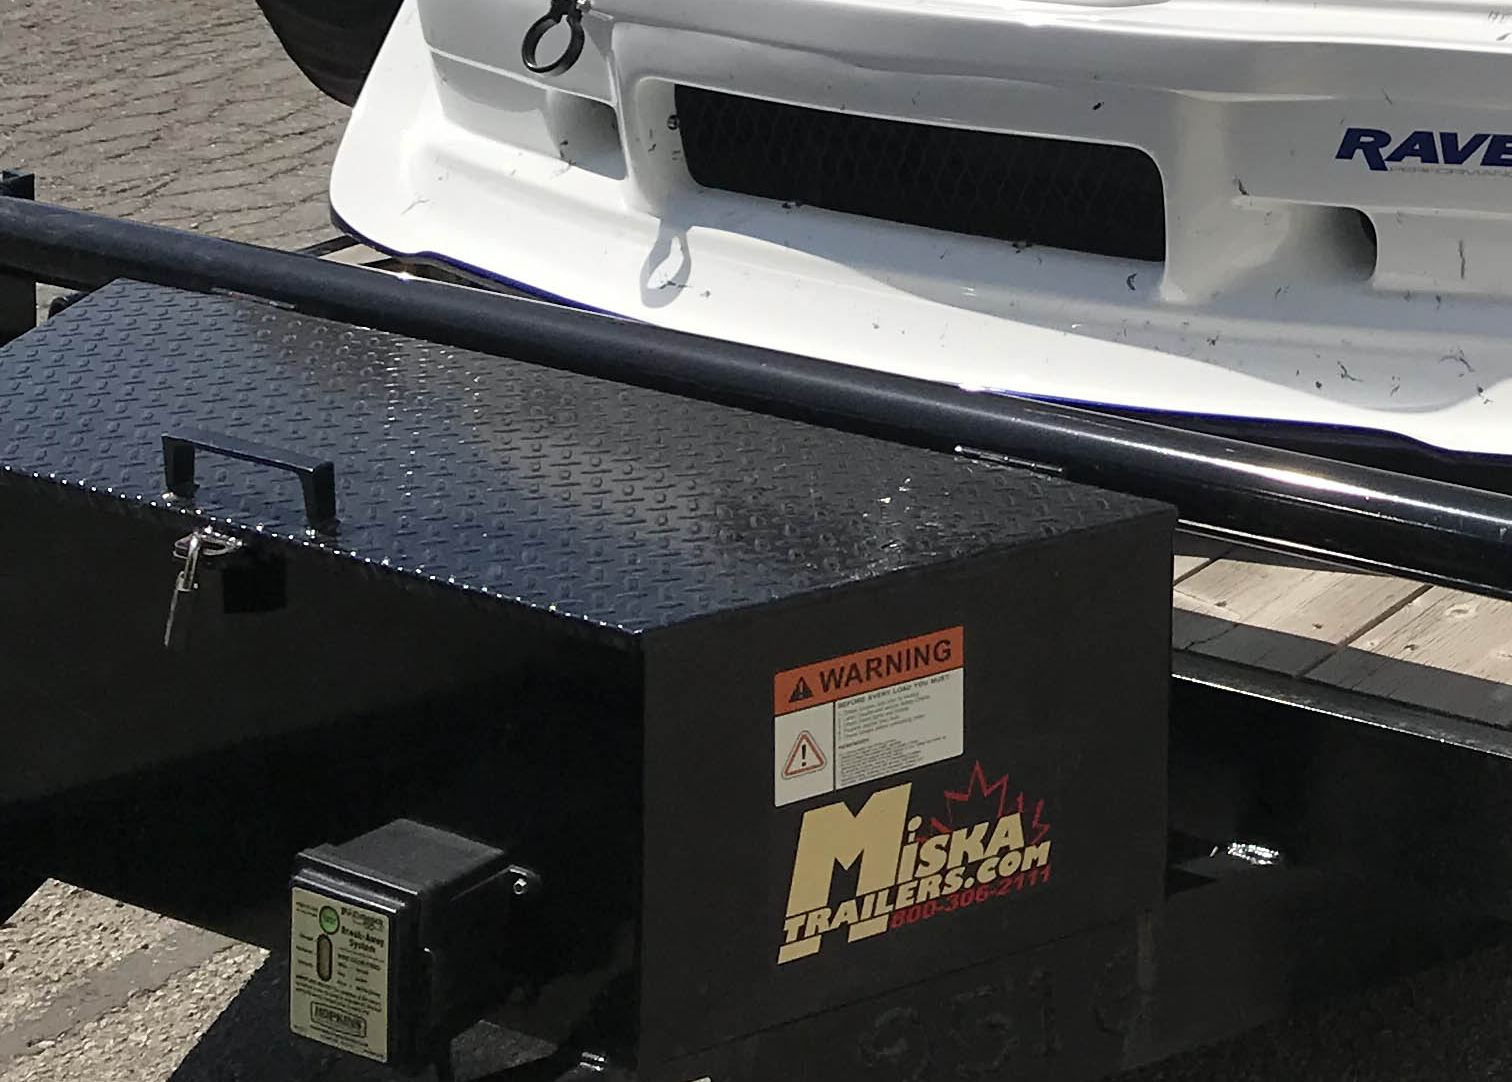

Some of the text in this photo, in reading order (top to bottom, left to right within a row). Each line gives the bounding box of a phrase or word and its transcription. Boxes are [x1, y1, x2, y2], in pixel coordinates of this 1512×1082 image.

[819, 639, 951, 694] WARNING
[783, 840, 1052, 944] TRAILERS.COM
[349, 938, 376, 953] System
